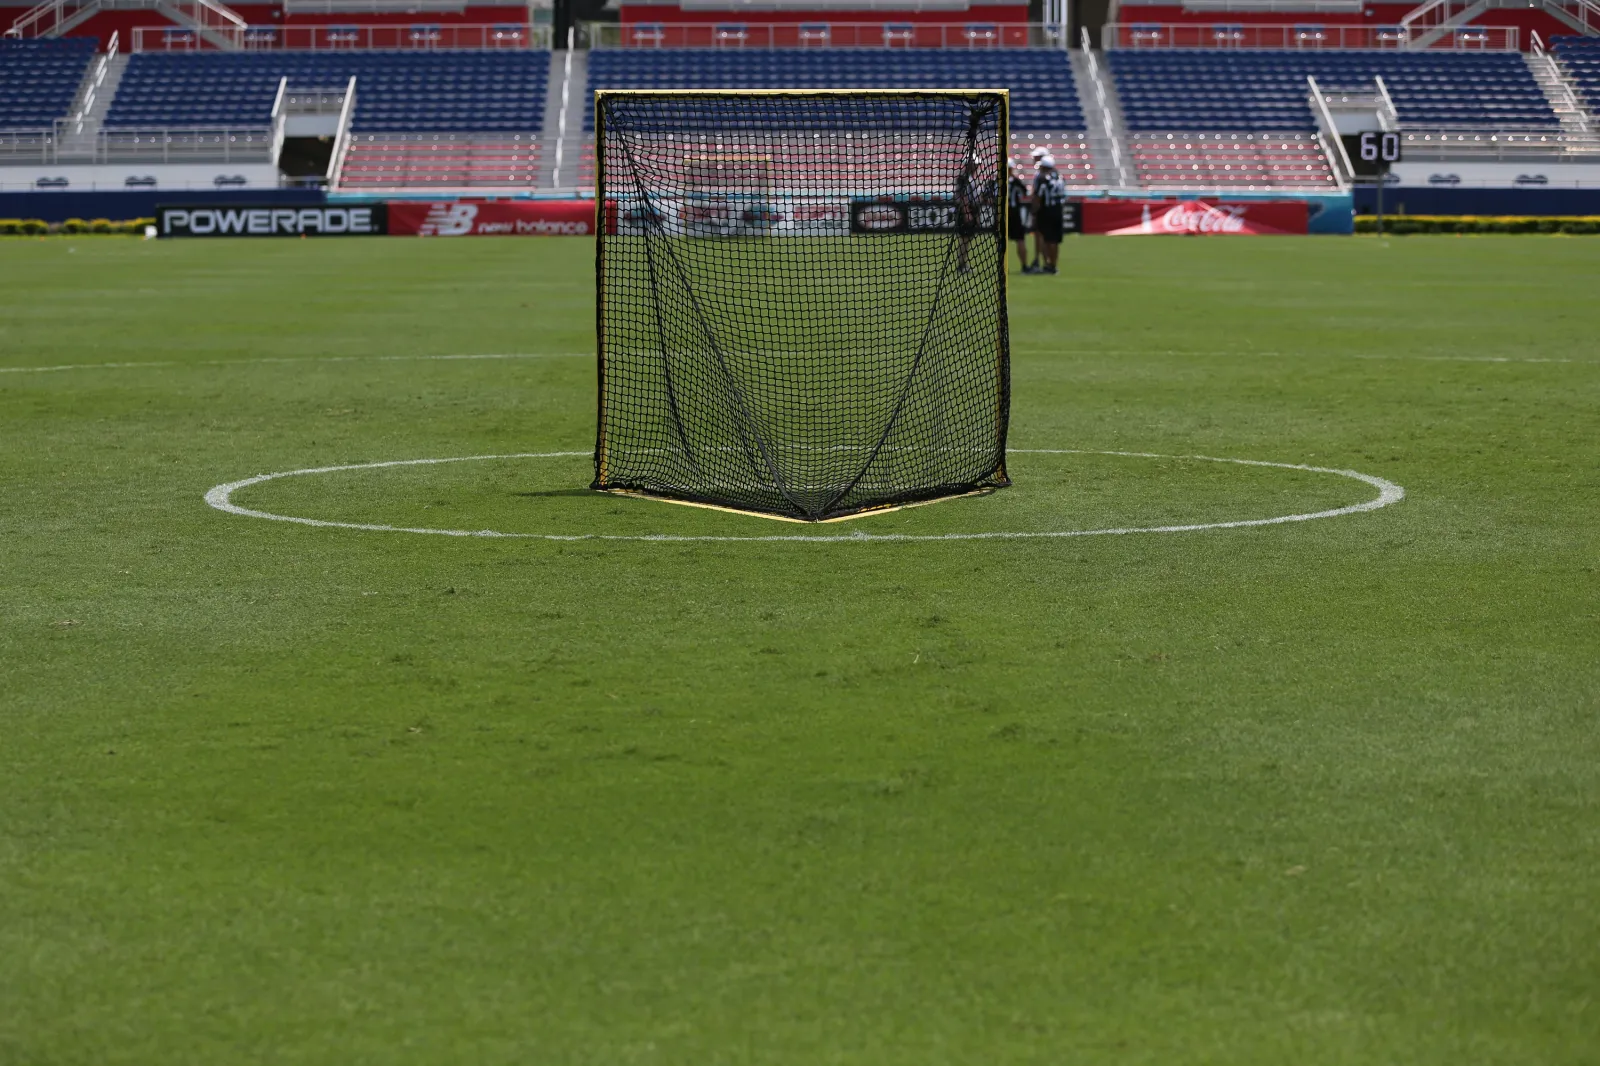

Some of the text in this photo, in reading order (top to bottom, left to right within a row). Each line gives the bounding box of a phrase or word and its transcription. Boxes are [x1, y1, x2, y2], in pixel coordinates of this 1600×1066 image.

[1360, 132, 1399, 161] 60
[163, 208, 372, 234] POWERADE
[478, 219, 588, 235] new balance
